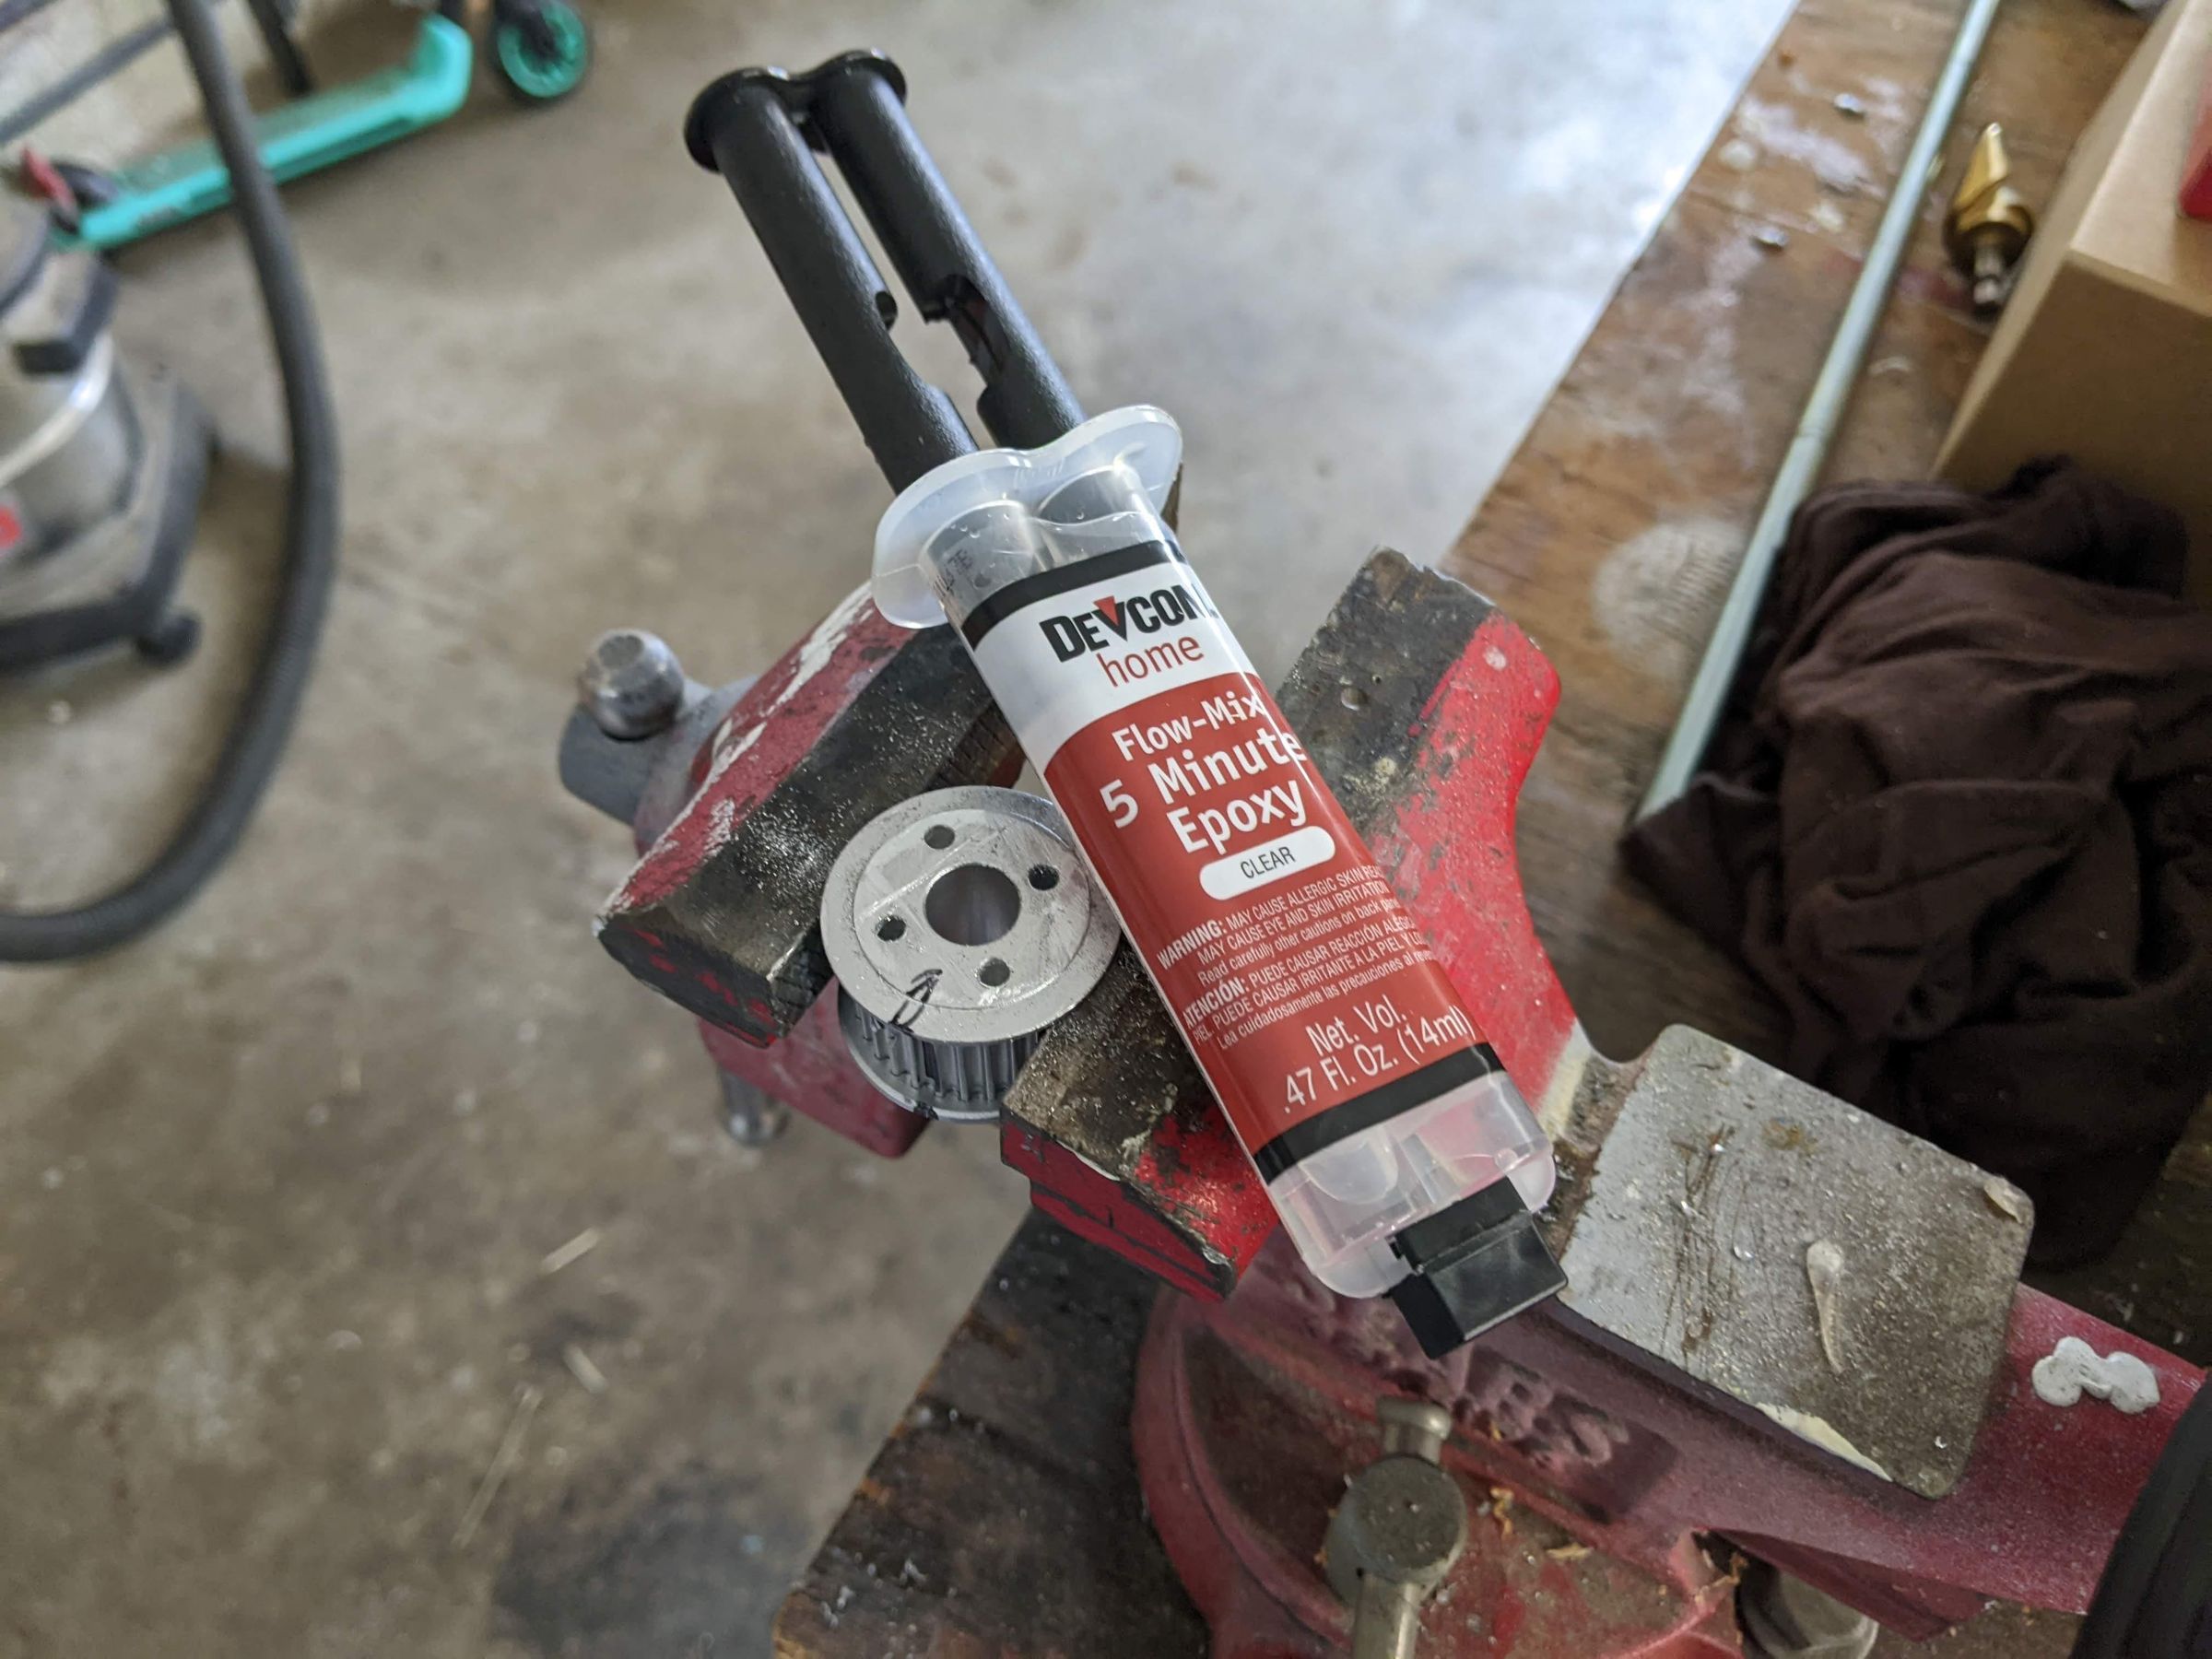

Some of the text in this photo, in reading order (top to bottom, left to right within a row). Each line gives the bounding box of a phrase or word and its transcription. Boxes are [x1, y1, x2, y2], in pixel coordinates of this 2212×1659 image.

[1039, 584, 1218, 663] DEVCON
[1097, 636, 1205, 688] home
[1112, 690, 1268, 761] Flow-Mix
[1100, 727, 1307, 829] 5 Minute
[1166, 780, 1307, 855] Epoxy
[1240, 845, 1296, 879] CLEAR
[1156, 919, 1228, 971] WARNING:
[1225, 908, 1253, 931] MAY
[1252, 896, 1288, 921] CAUSE
[1287, 877, 1337, 907] ALLERGIC
[1335, 867, 1365, 888] SKIN
[1197, 938, 1226, 966] MAY
[1227, 924, 1266, 950] CAUSE
[1263, 916, 1287, 935] EYE
[1285, 907, 1309, 928] AND
[1307, 897, 1335, 918] SKIN
[1197, 959, 1230, 988] Read
[1229, 941, 1275, 971] carefully
[1274, 932, 1300, 952] other
[1300, 916, 1343, 941] cautions
[1340, 911, 1357, 925] on
[1353, 900, 1382, 919] back
[1182, 976, 1251, 1030] ATENCIÓN:
[1248, 961, 1288, 989] PUEDE
[1286, 945, 1332, 974] CAUSAR
[1328, 923, 1383, 958] REACCIÓN
[1211, 996, 1253, 1030] PUEDE
[1253, 977, 1301, 1008] CAUSAR
[1298, 955, 1356, 989] IRRITANTE
[1353, 951, 1365, 967] A
[1360, 945, 1381, 963] LA
[1376, 935, 1406, 957] PIEL
[1400, 931, 1414, 948] Y
[1217, 1030, 1240, 1050] Lea
[1238, 990, 1324, 1038] cuidadosamente
[1321, 984, 1341, 1001] las
[1337, 956, 1405, 995] precauciones
[1402, 950, 1415, 967] al
[1284, 1005, 1477, 1114] .47 Fl. Oz. (14ml)
[1305, 994, 1407, 1057] Net. Vol.
